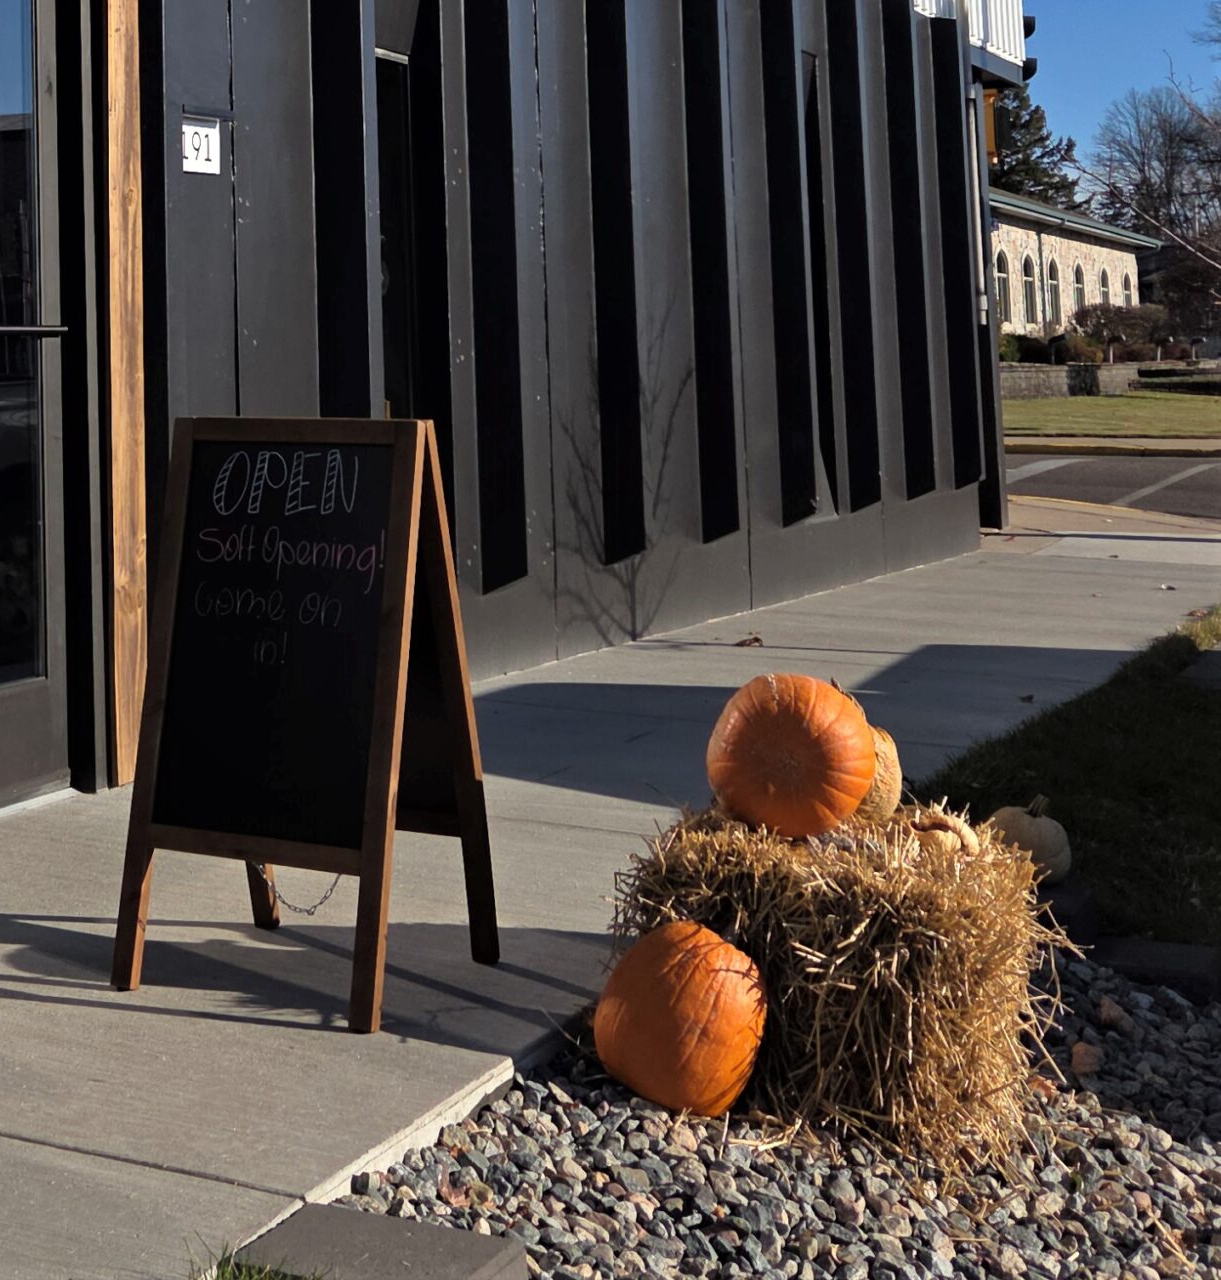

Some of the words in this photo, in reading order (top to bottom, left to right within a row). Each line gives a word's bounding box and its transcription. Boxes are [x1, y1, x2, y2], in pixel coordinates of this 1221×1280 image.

[213, 449, 358, 516] OPEN
[196, 527, 255, 563] Soft
[262, 525, 384, 595] Opening!
